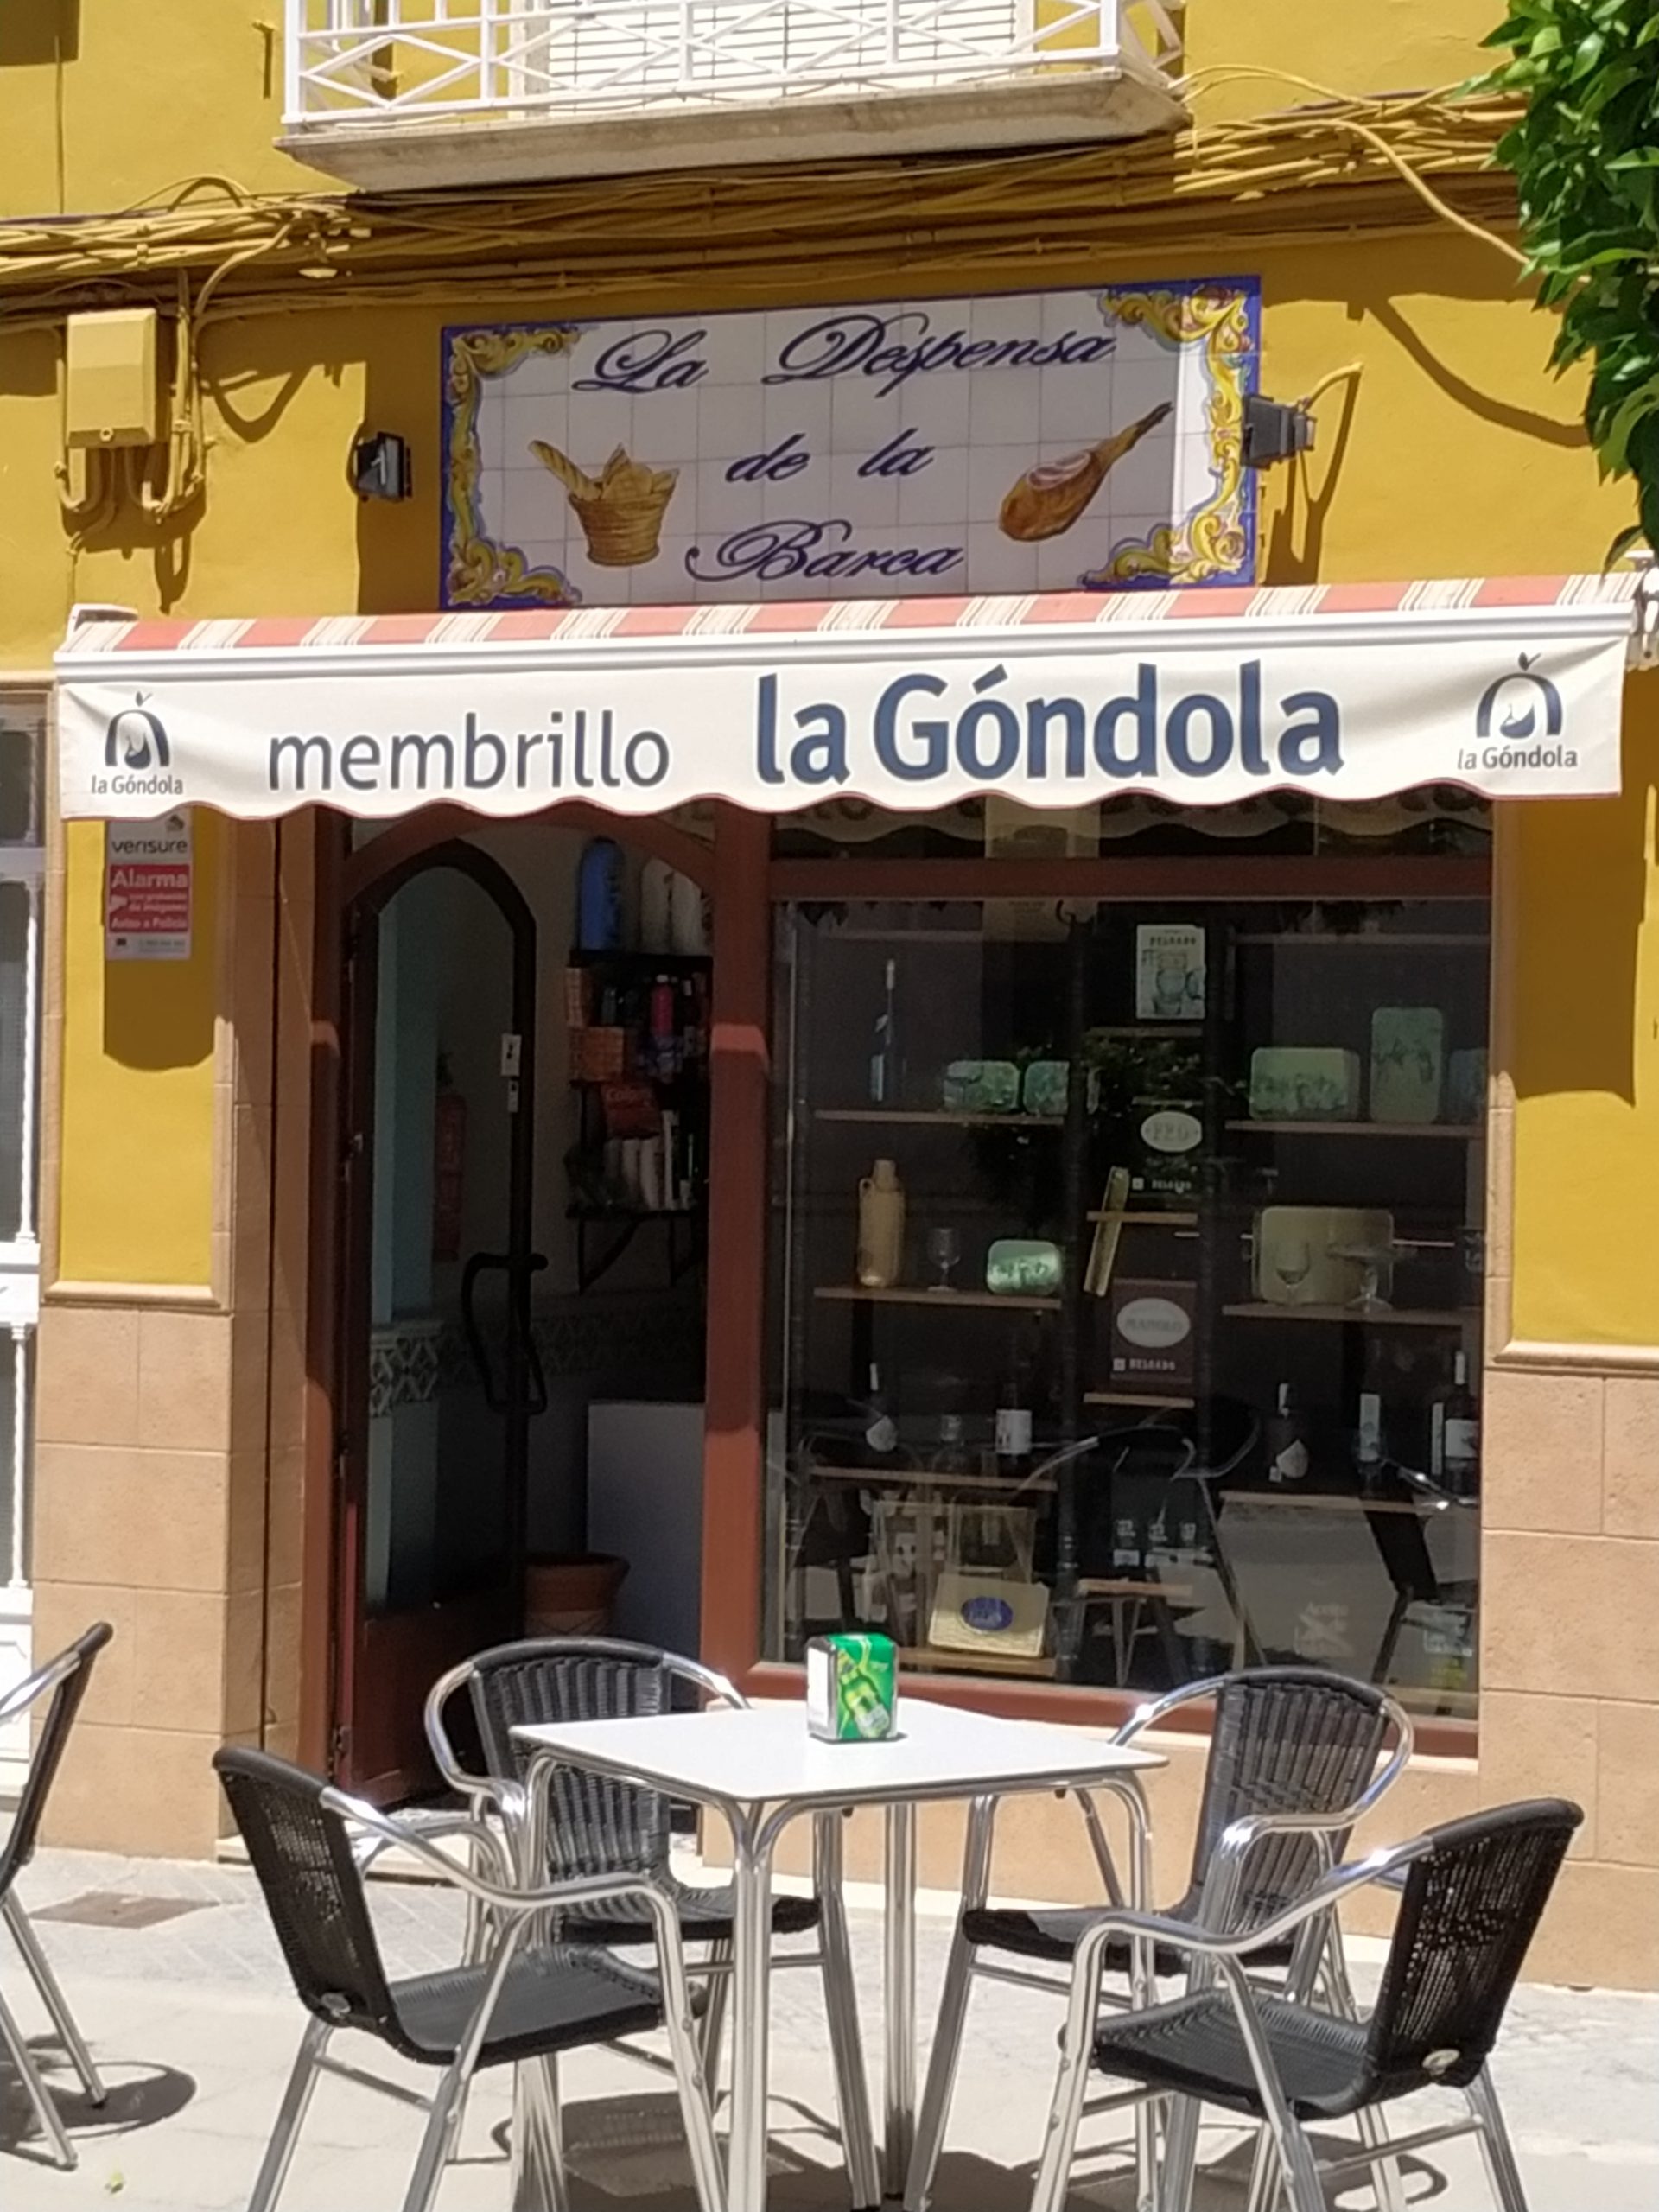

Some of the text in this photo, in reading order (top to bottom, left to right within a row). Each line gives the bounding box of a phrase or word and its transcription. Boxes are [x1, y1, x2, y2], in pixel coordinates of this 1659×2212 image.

[572, 314, 1118, 399] La Despensa
[724, 428, 938, 484] de la
[685, 519, 970, 581] Barca
[269, 709, 671, 791] membrillo
[757, 659, 1346, 786] la Góndola
[91, 773, 184, 795] la Góndola
[1458, 745, 1578, 770] la Góndola
[111, 839, 188, 854] verisure
[111, 868, 188, 888] Alarma
